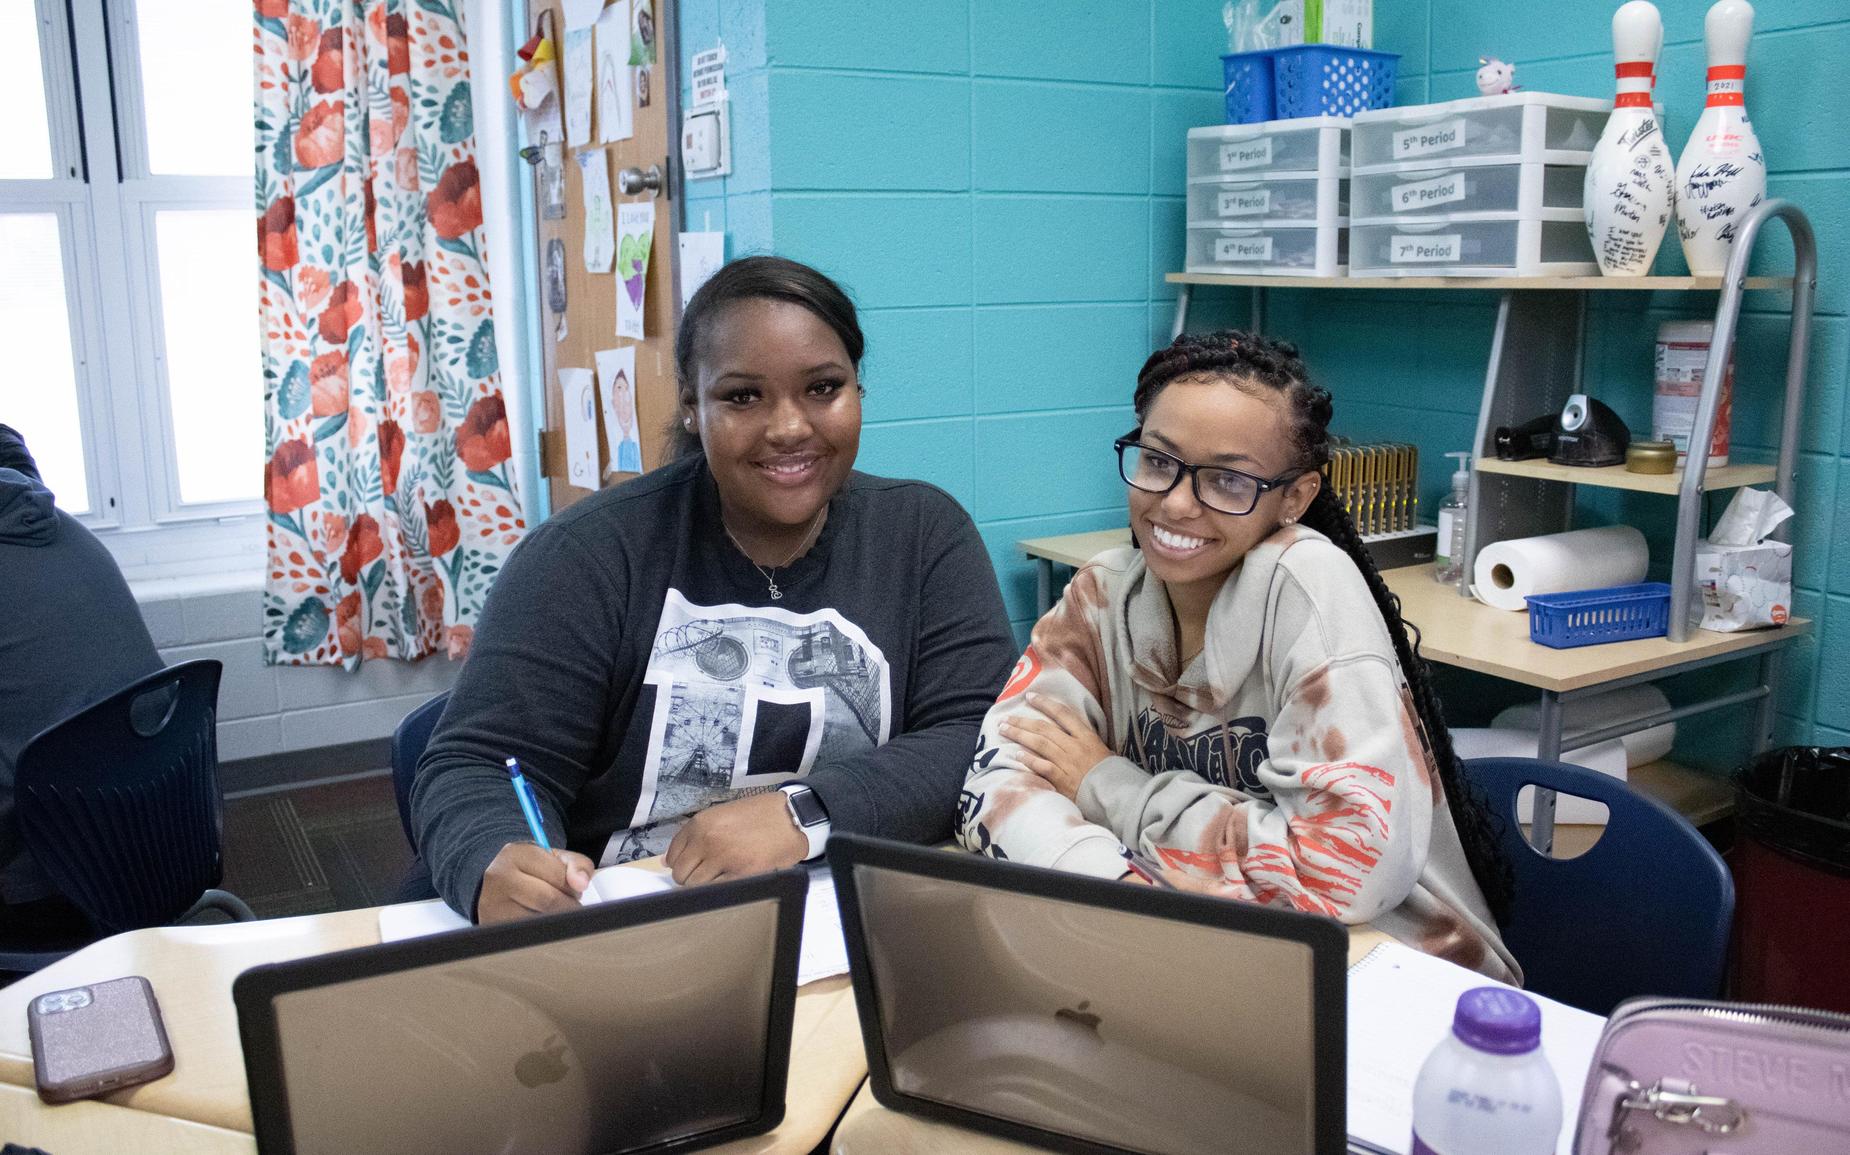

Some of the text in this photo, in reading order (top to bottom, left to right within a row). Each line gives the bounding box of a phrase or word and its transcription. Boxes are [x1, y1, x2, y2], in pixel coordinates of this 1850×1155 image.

[1714, 82, 1735, 90] 2021
[1403, 129, 1456, 150] 5th Period
[1239, 147, 1266, 161] Period
[1402, 183, 1455, 203] 6th Period
[1238, 196, 1265, 208] Period
[1238, 243, 1265, 255] Period
[1400, 244, 1452, 257] 7th Period
[1681, 1041, 1809, 1094] STEVE
